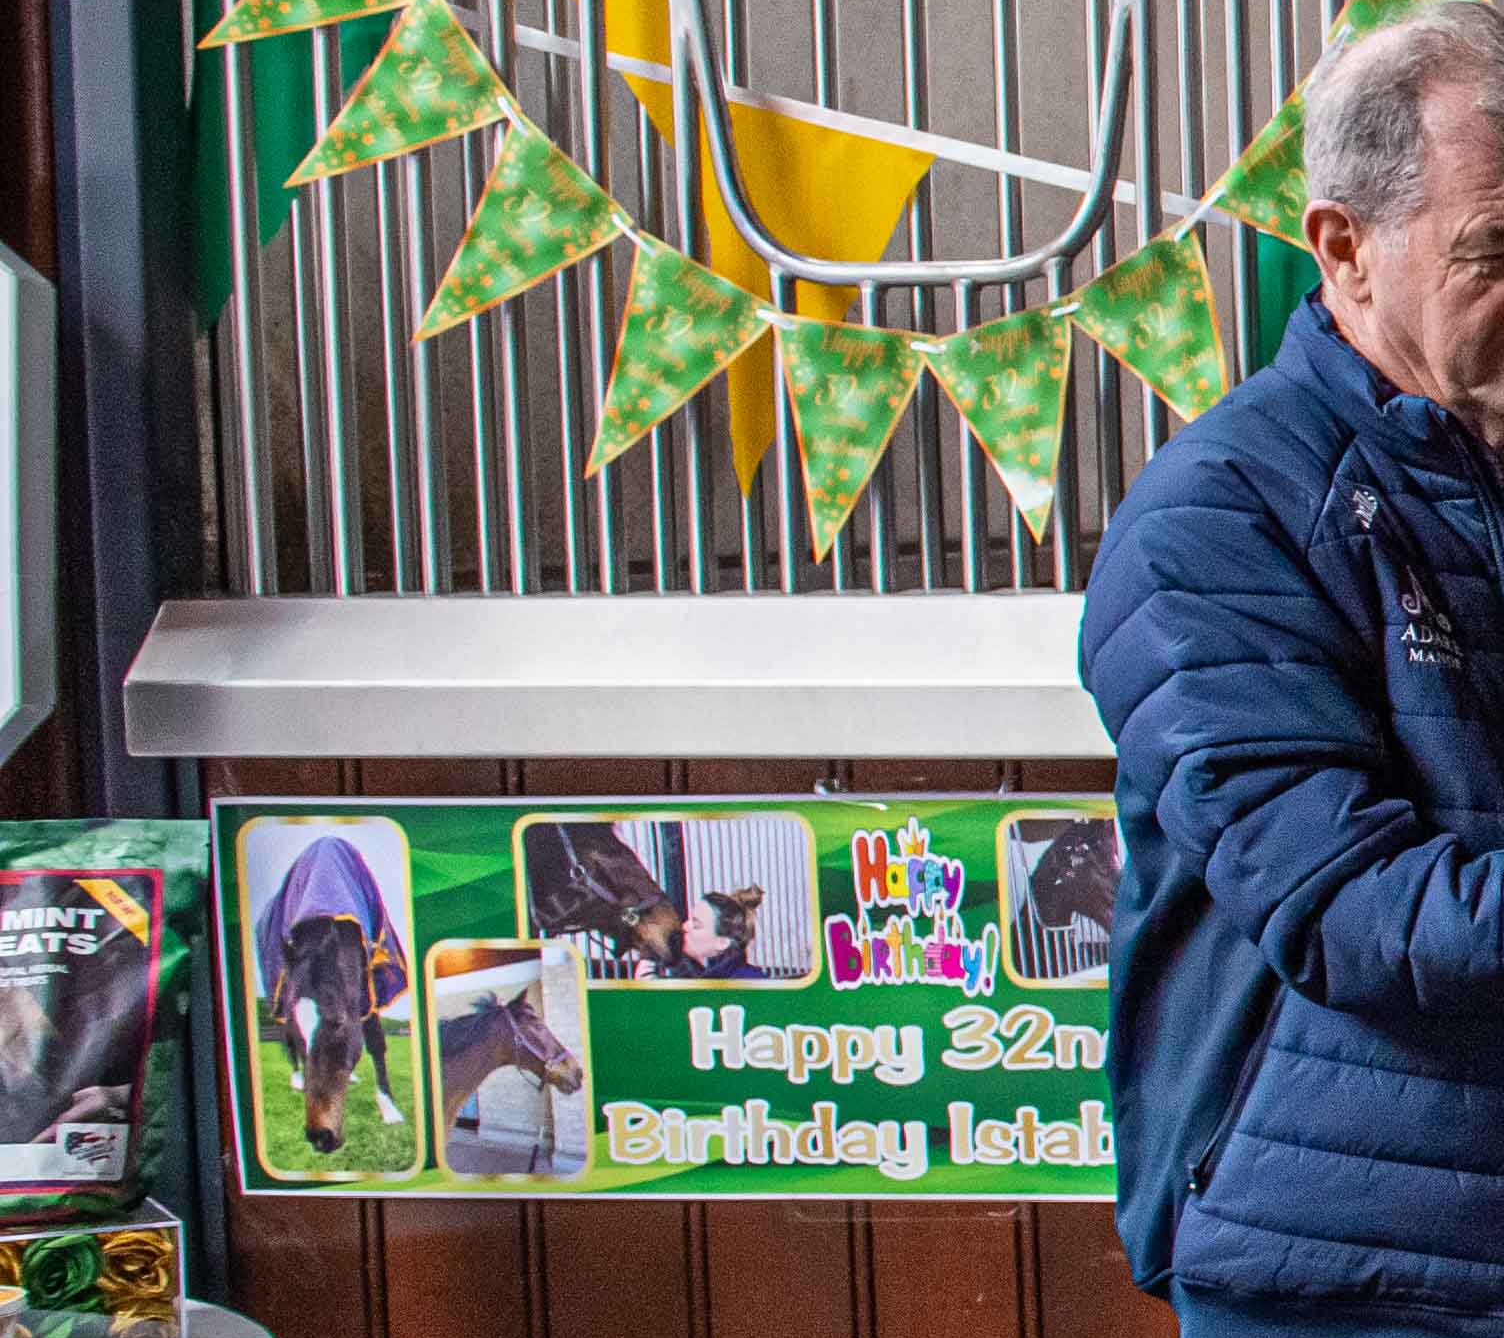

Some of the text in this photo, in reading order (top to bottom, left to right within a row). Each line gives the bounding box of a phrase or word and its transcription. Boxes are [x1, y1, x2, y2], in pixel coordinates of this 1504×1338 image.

[852, 825, 966, 916] Happy
[689, 1004, 1110, 1085] Happy 32n
[602, 1099, 929, 1180] Birthday
